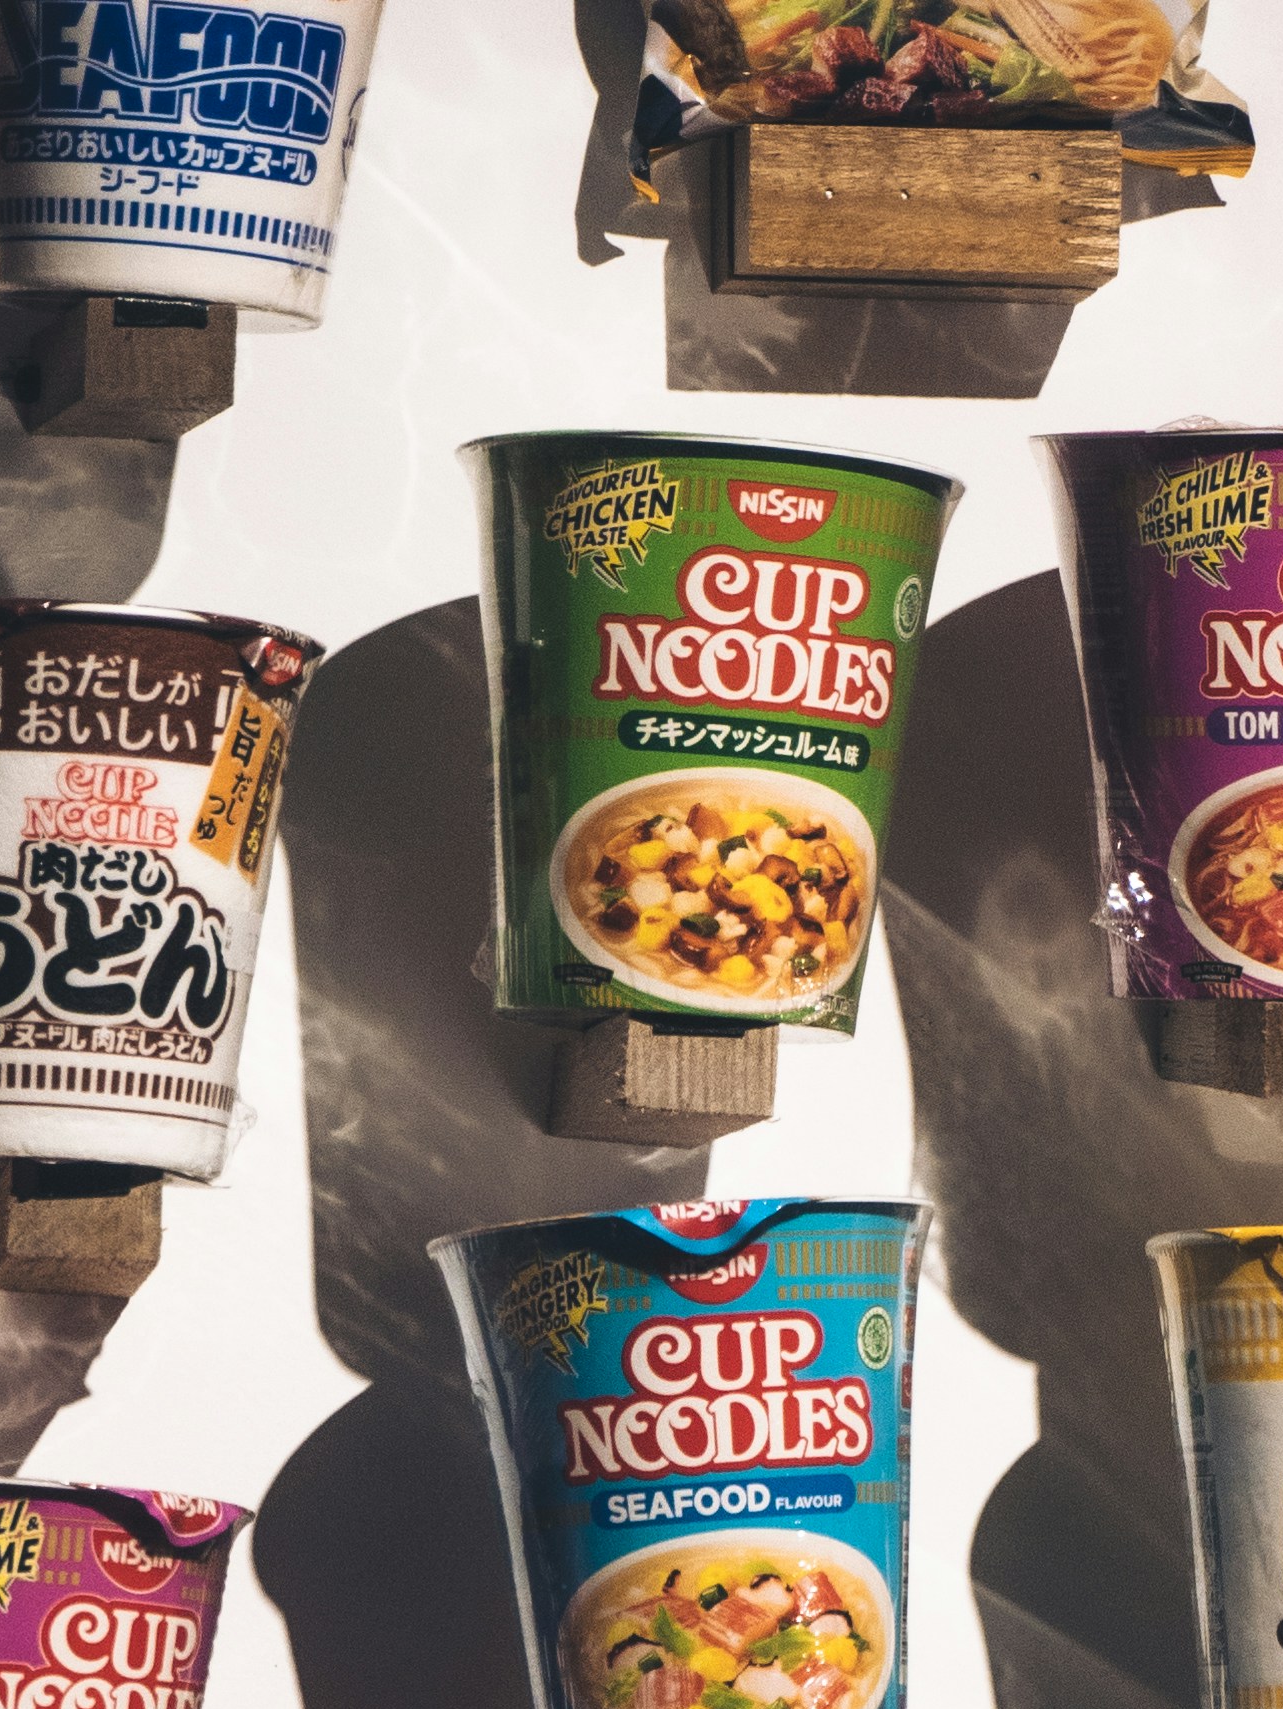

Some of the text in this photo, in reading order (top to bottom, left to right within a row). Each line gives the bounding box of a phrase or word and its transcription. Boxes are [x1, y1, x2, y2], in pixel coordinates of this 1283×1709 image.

[100, 166, 200, 196] シーフード
[545, 485, 677, 540] CHICKEN
[739, 489, 825, 523] NISSIN
[1199, 485, 1270, 530] LIME
[572, 523, 629, 549] TASTE
[685, 552, 867, 637] CUP
[23, 649, 202, 706] おだしが
[599, 620, 895, 721] NOODLES
[16, 700, 199, 752] おいしい
[635, 715, 862, 769] チキンマッシュルーム味
[1224, 709, 1281, 741] TOM
[56, 761, 159, 801] CUP
[629, 1318, 817, 1395] CUP
[566, 1386, 870, 1479] NOODLES
[608, 1484, 843, 1525] SEAFOOD FLAVOUR
[47, 1602, 198, 1684] CUP
